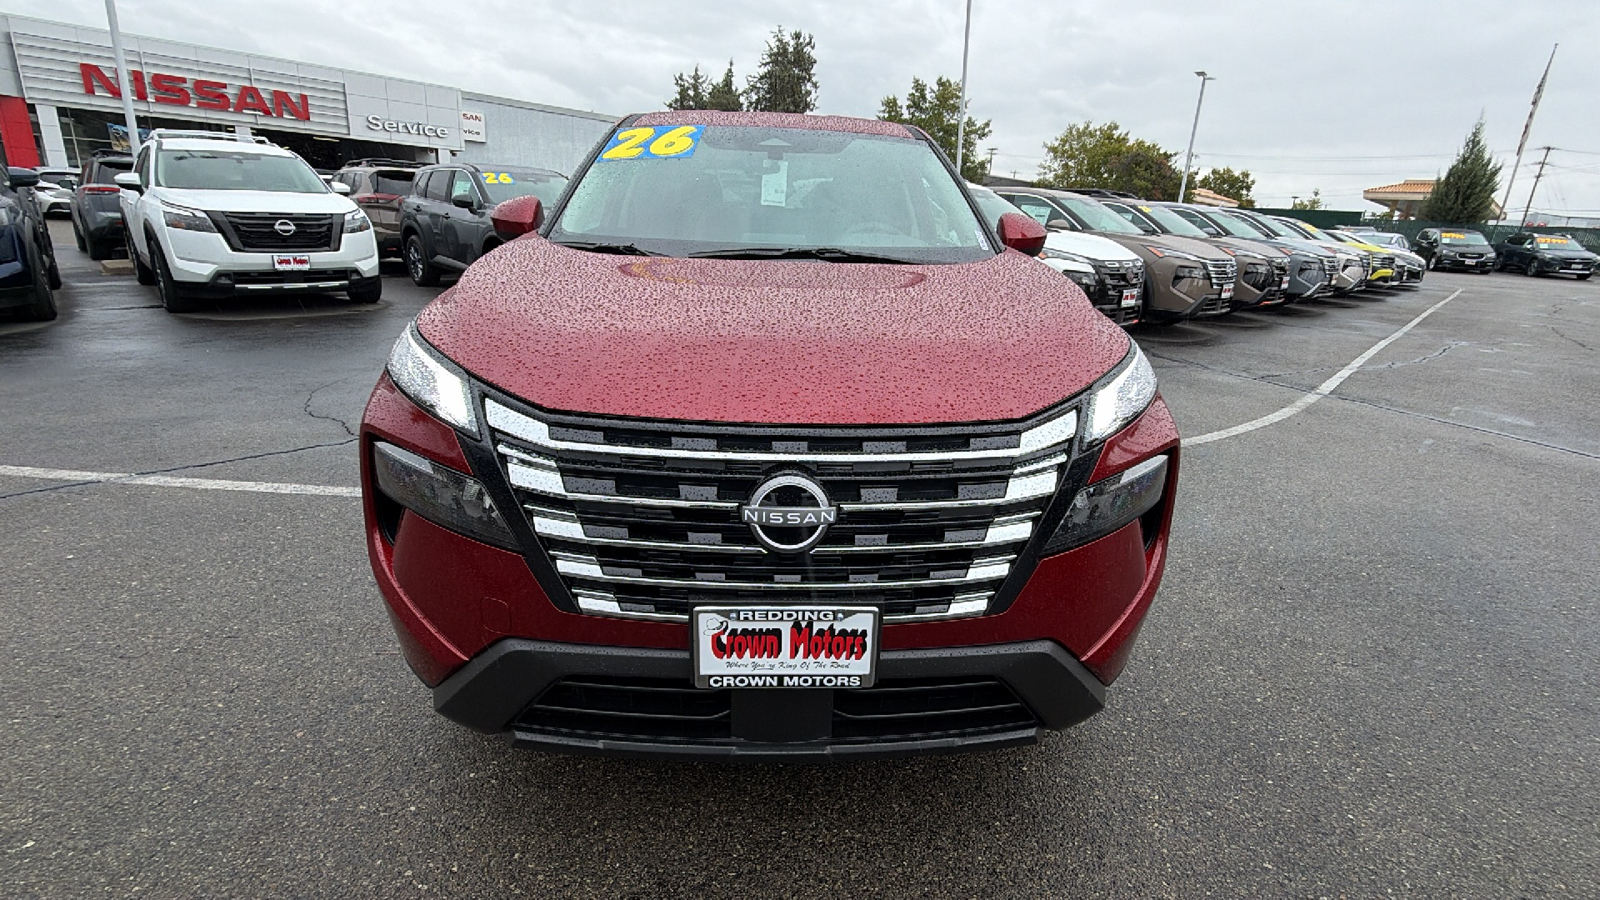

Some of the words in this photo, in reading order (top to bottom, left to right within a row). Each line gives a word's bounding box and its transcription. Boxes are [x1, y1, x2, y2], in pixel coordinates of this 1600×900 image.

[79, 62, 311, 121] NISSAN
[366, 114, 449, 138] Service
[602, 125, 697, 159] 26
[482, 172, 513, 184] 26
[744, 509, 835, 524] NISSAN
[739, 610, 834, 621] REDDING
[711, 622, 782, 660] Crown
[789, 621, 868, 661] Motors
[725, 661, 749, 669] Where
[778, 661, 798, 671] King
[800, 661, 811, 670] Of
[814, 661, 827, 669] The
[830, 661, 851, 669] Road
[709, 676, 778, 687] CROWN
[783, 676, 861, 687] MOTORS
